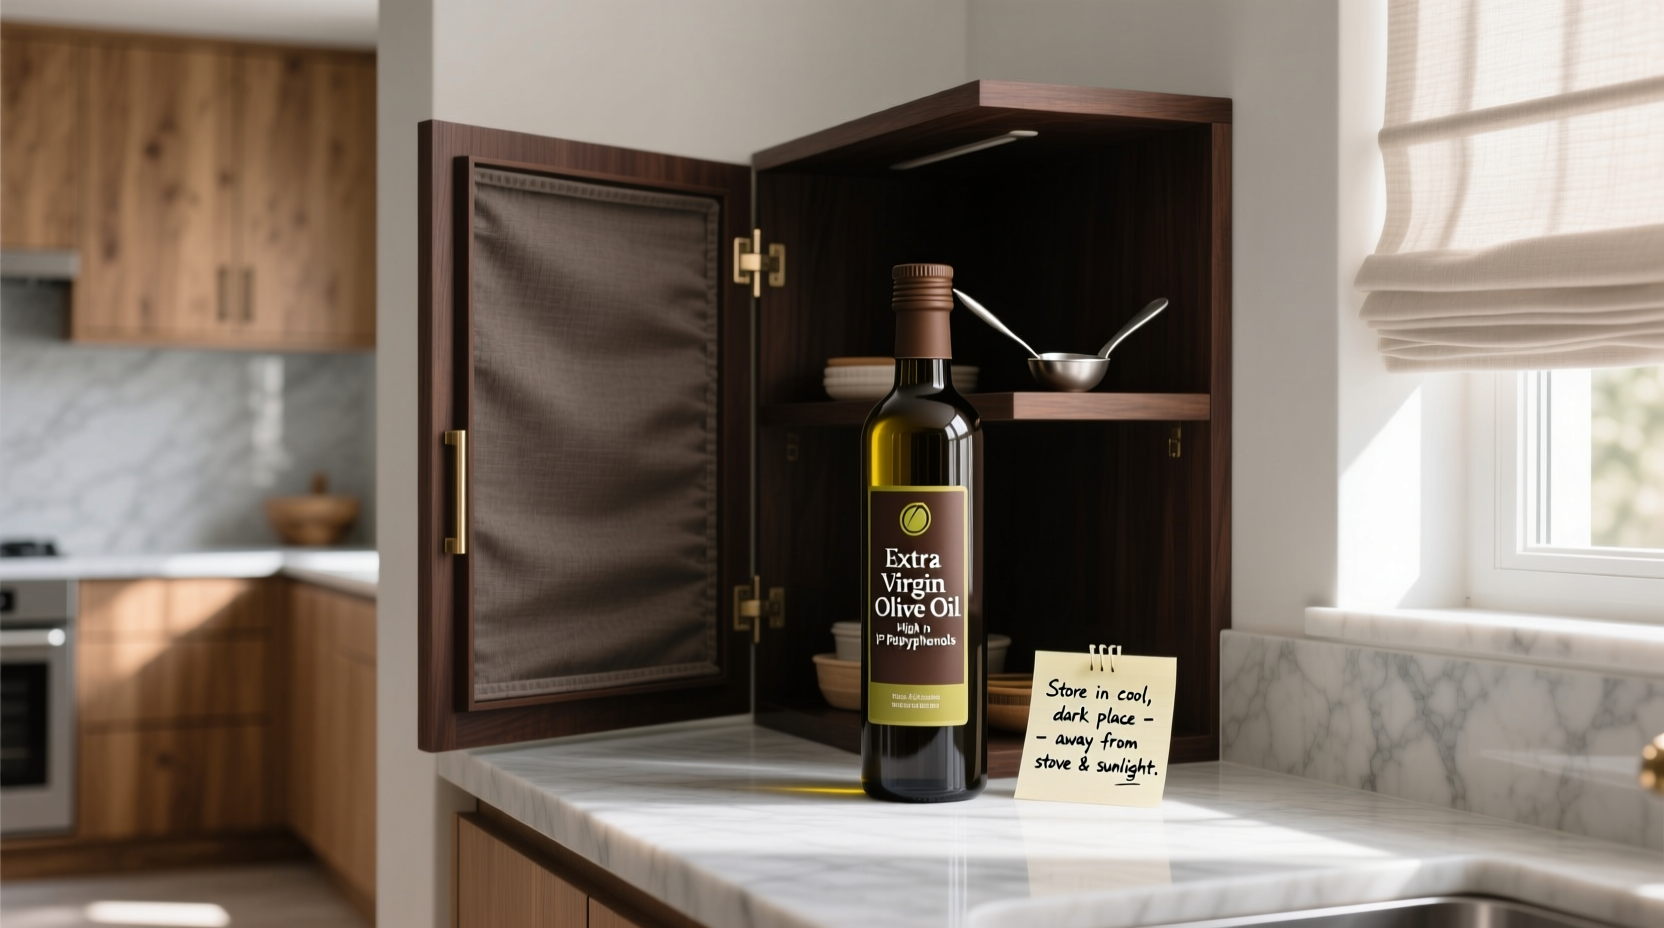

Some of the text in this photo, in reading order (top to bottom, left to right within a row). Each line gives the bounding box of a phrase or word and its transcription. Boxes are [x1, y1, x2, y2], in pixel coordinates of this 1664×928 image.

[885, 548, 942, 568] Extra
[881, 572, 946, 600] Virgin
[875, 596, 961, 618] Olive Oil
[1046, 679, 1151, 706] Store in cool,
[1053, 705, 1089, 723] dark
[1096, 707, 1135, 730] place
[1055, 734, 1093, 754] away
[1100, 732, 1138, 750] from
[1034, 754, 1158, 781] stove & sunlight.
